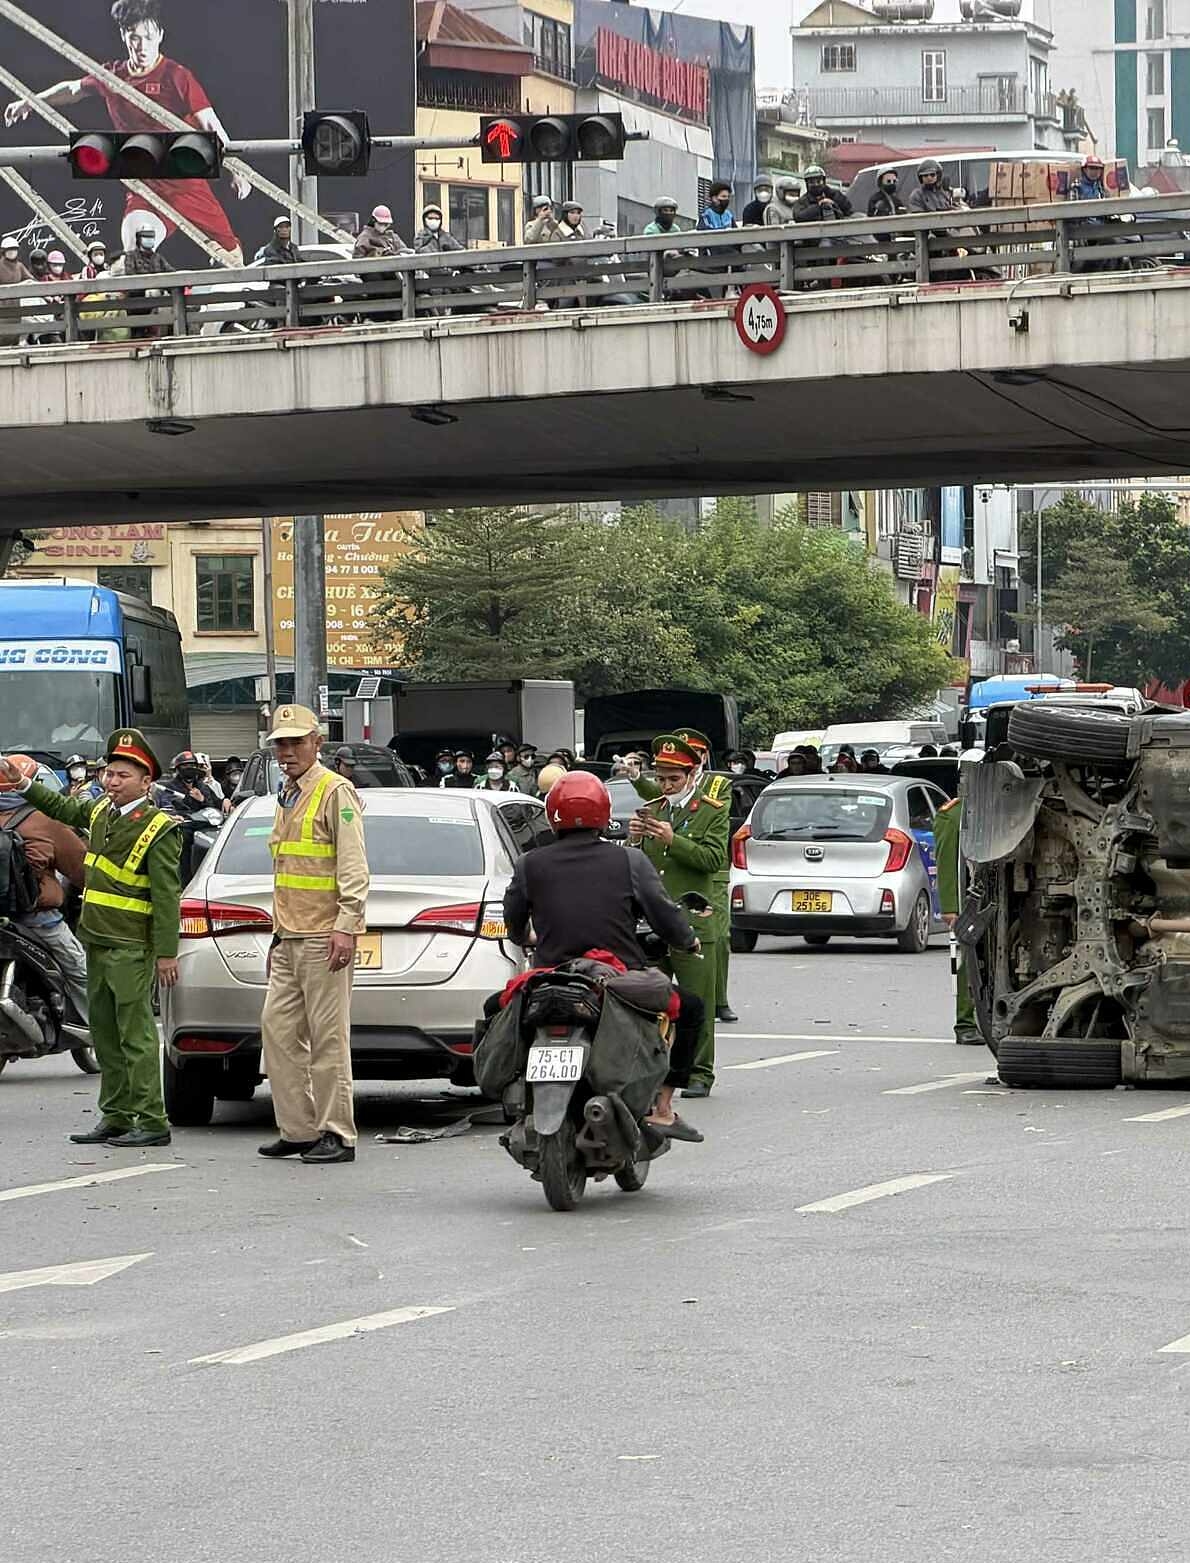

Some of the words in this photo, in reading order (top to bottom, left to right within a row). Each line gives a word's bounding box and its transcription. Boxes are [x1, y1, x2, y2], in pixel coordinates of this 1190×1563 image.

[748, 307, 773, 336] 4,75m
[325, 583, 356, 599] HUÊ
[34, 646, 109, 665] CÔNG
[538, 1050, 573, 1063] 75-C1
[530, 1065, 578, 1079] 264.00
